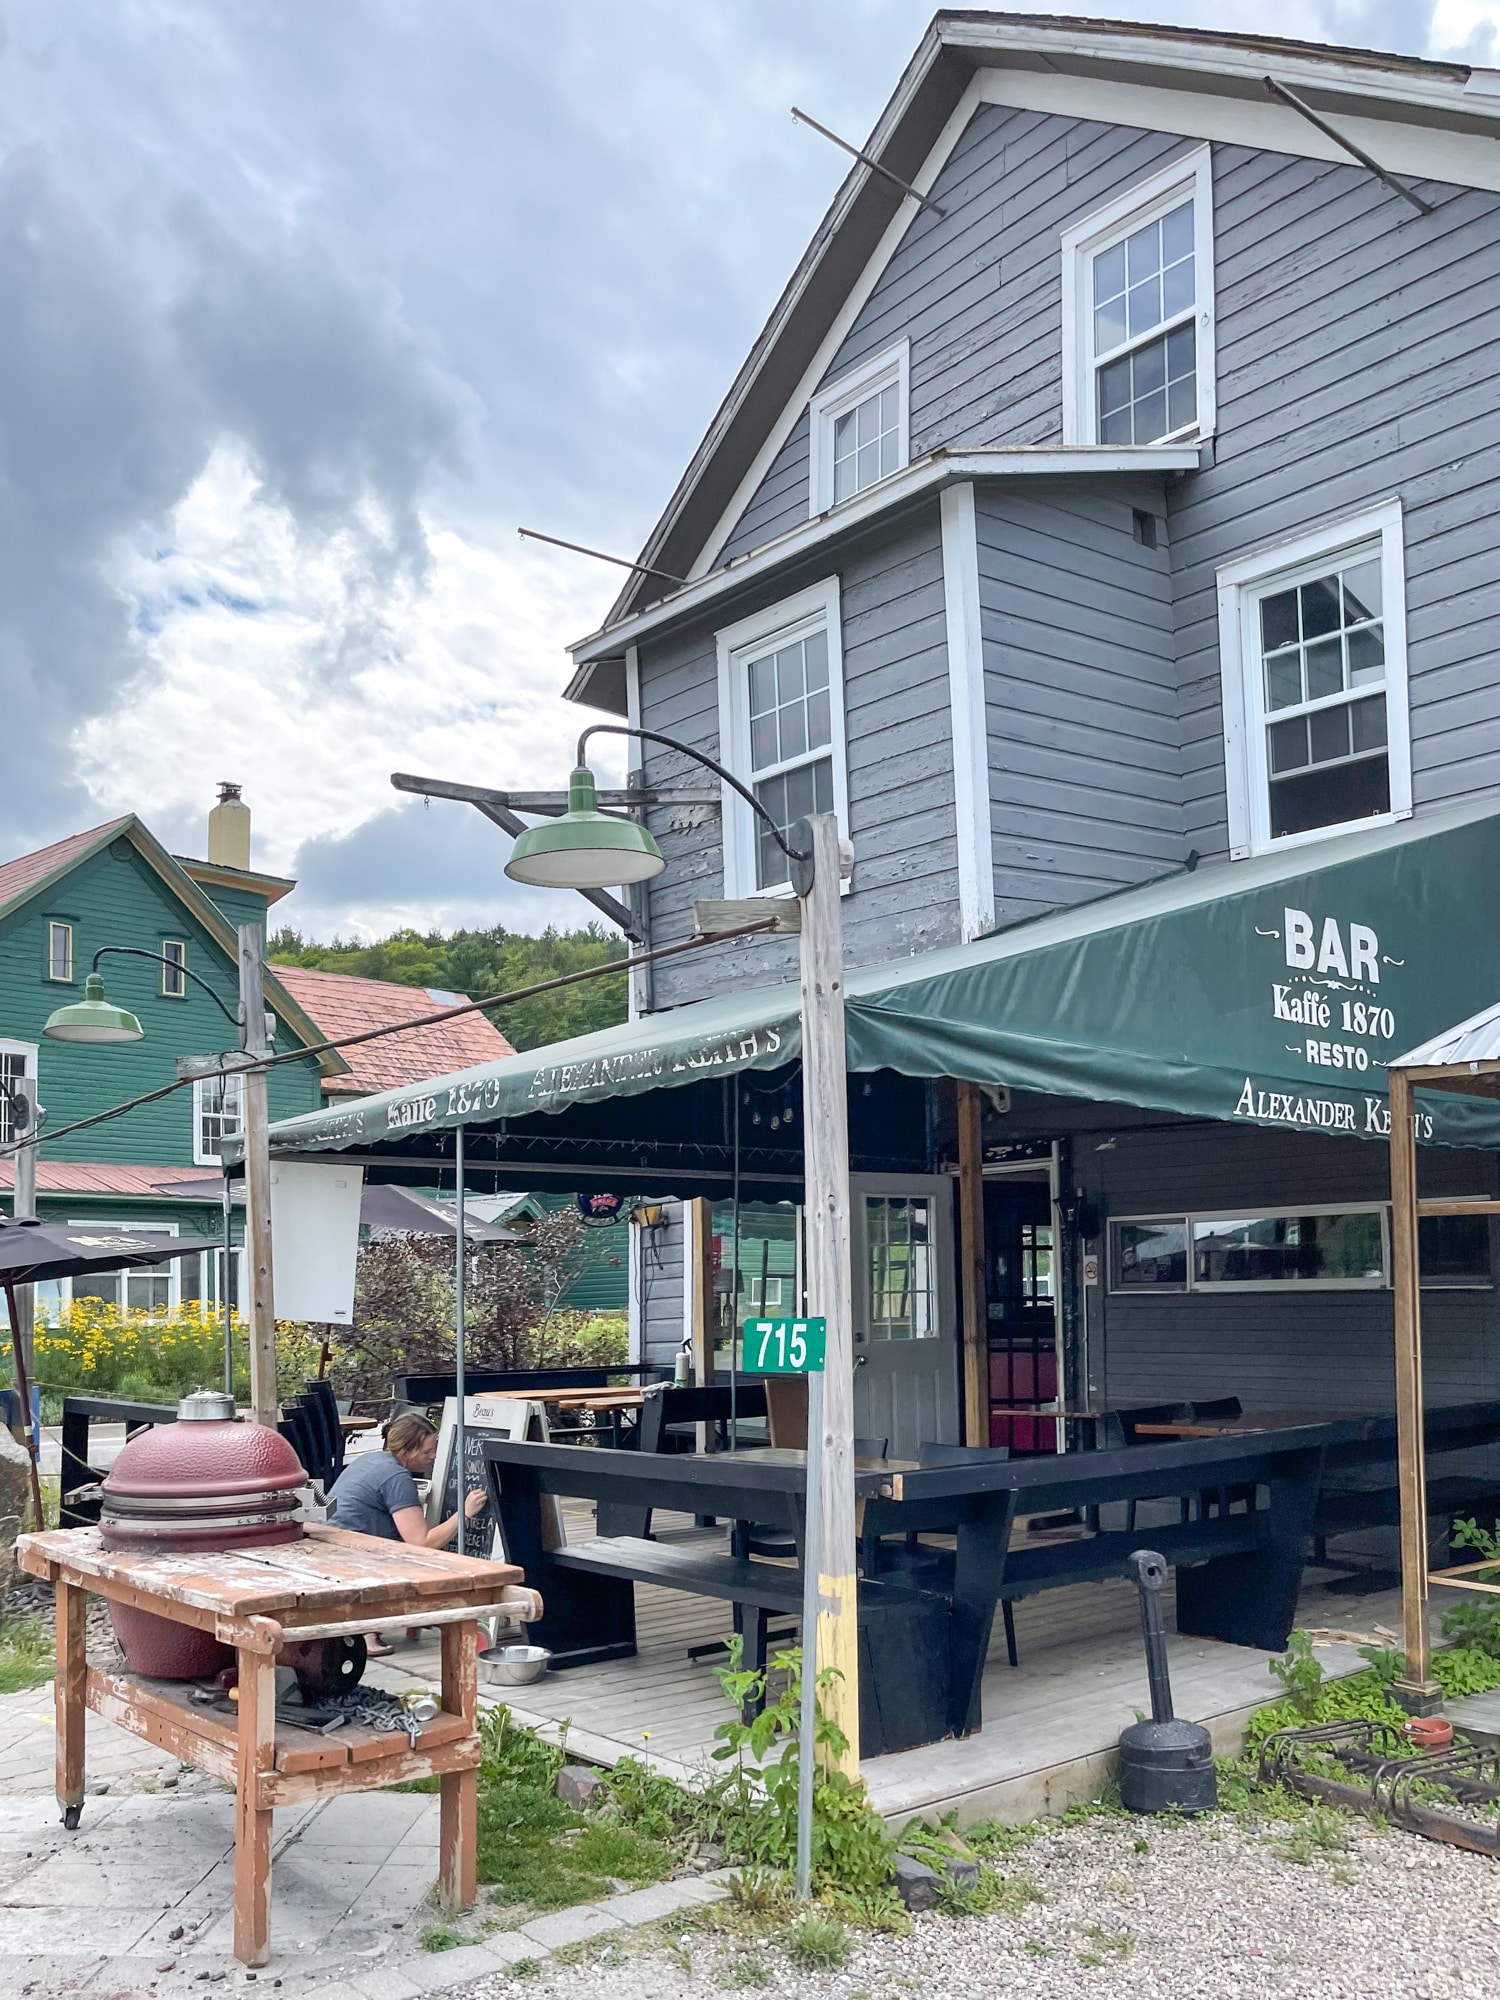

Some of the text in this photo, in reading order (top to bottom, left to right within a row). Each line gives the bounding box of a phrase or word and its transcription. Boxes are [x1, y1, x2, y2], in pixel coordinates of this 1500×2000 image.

[1284, 908, 1380, 984] BAR
[1271, 984, 1395, 1039] Kaffé 1870
[1305, 1039, 1368, 1071] RESTO
[445, 1078, 500, 1116] 1870
[1233, 1077, 1433, 1139] ALEXANDER KE'S
[756, 1322, 807, 1367] 715
